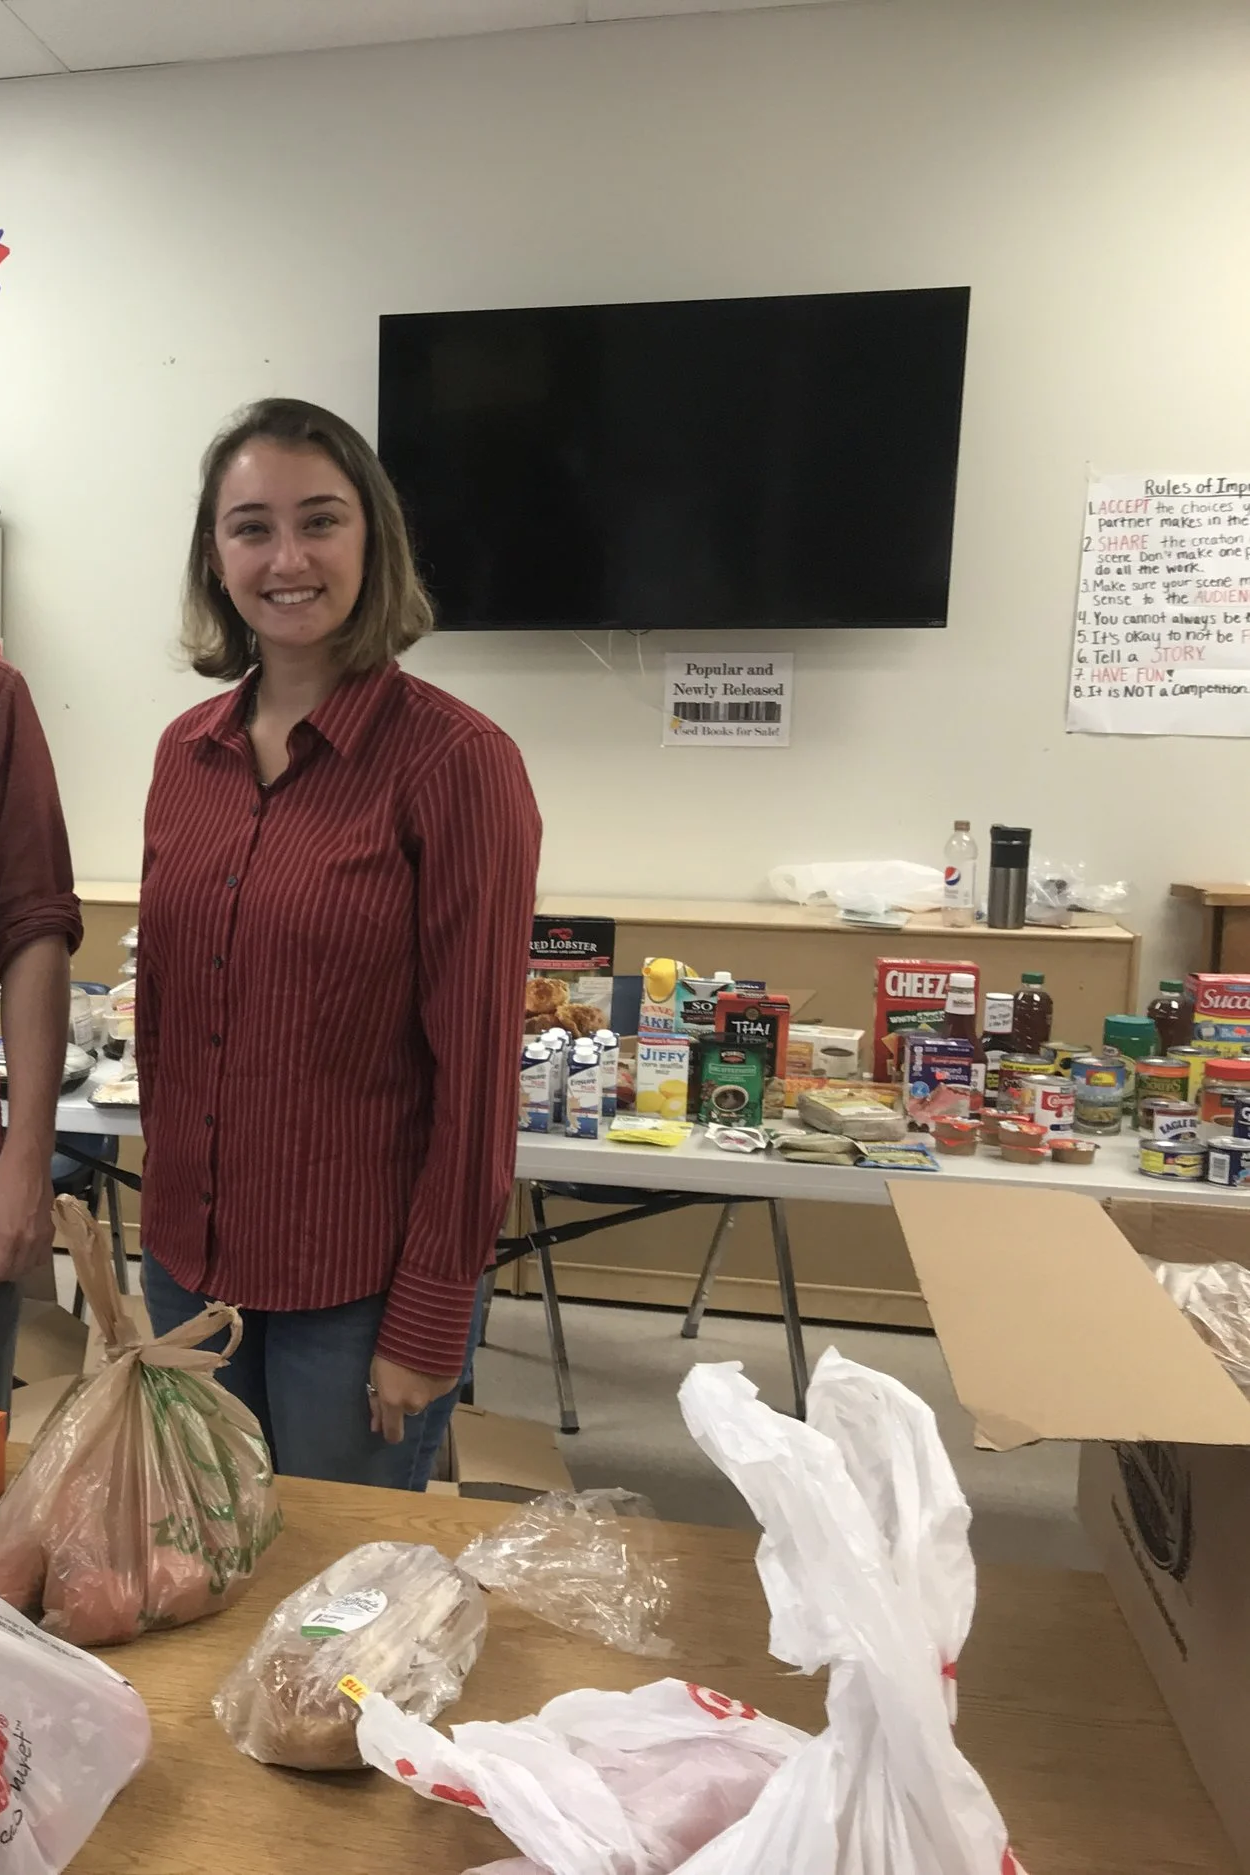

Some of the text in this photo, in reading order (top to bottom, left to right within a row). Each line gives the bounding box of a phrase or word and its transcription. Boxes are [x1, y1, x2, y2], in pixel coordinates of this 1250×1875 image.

[1145, 479, 1191, 495] Rules
[1196, 478, 1212, 494] of
[1099, 499, 1151, 515] ACCEPT
[1155, 501, 1174, 515] the
[1181, 501, 1233, 514] choices
[1098, 514, 1250, 532] partner makes in the
[1098, 534, 1149, 551] SHARE
[1160, 535, 1186, 548] the
[1191, 533, 1243, 547] creation
[1176, 548, 1213, 560] make
[1219, 547, 1241, 558] one
[1095, 564, 1111, 576] do
[1116, 564, 1131, 575] all
[1137, 563, 1159, 575] the
[1093, 579, 1126, 592] Make
[1132, 580, 1157, 590] sure
[1162, 579, 1192, 594] your
[1196, 576, 1232, 588] scene
[1093, 594, 1132, 606] sense
[1142, 593, 1154, 604] to
[1166, 592, 1189, 604] the
[1093, 611, 1118, 625] You
[1123, 612, 1166, 625] cannot
[1171, 612, 1216, 630] always
[1223, 611, 1241, 624] be
[1092, 630, 1120, 645] It's
[1167, 630, 1181, 641] to
[1186, 628, 1213, 641] not
[1217, 630, 1234, 643] be
[1093, 649, 1121, 664] Tell
[1128, 653, 1139, 663] a
[1151, 646, 1206, 663] STORY
[684, 662, 774, 679] Popular and
[1091, 667, 1130, 682] HAVE
[672, 682, 784, 698] Newly Released
[1088, 685, 1103, 697] It
[1108, 686, 1120, 698] is
[1124, 685, 1156, 698] NOT
[1159, 688, 1169, 697] a
[701, 726, 734, 736] Books
[736, 726, 752, 736] for
[529, 938, 598, 953] RED LOBSTER
[885, 969, 948, 1000] CHEEZ
[691, 1001, 713, 1011] SO
[731, 1020, 771, 1036] THAI
[640, 1047, 686, 1063] JIFFY
[1158, 1118, 1187, 1135] EAGLE
